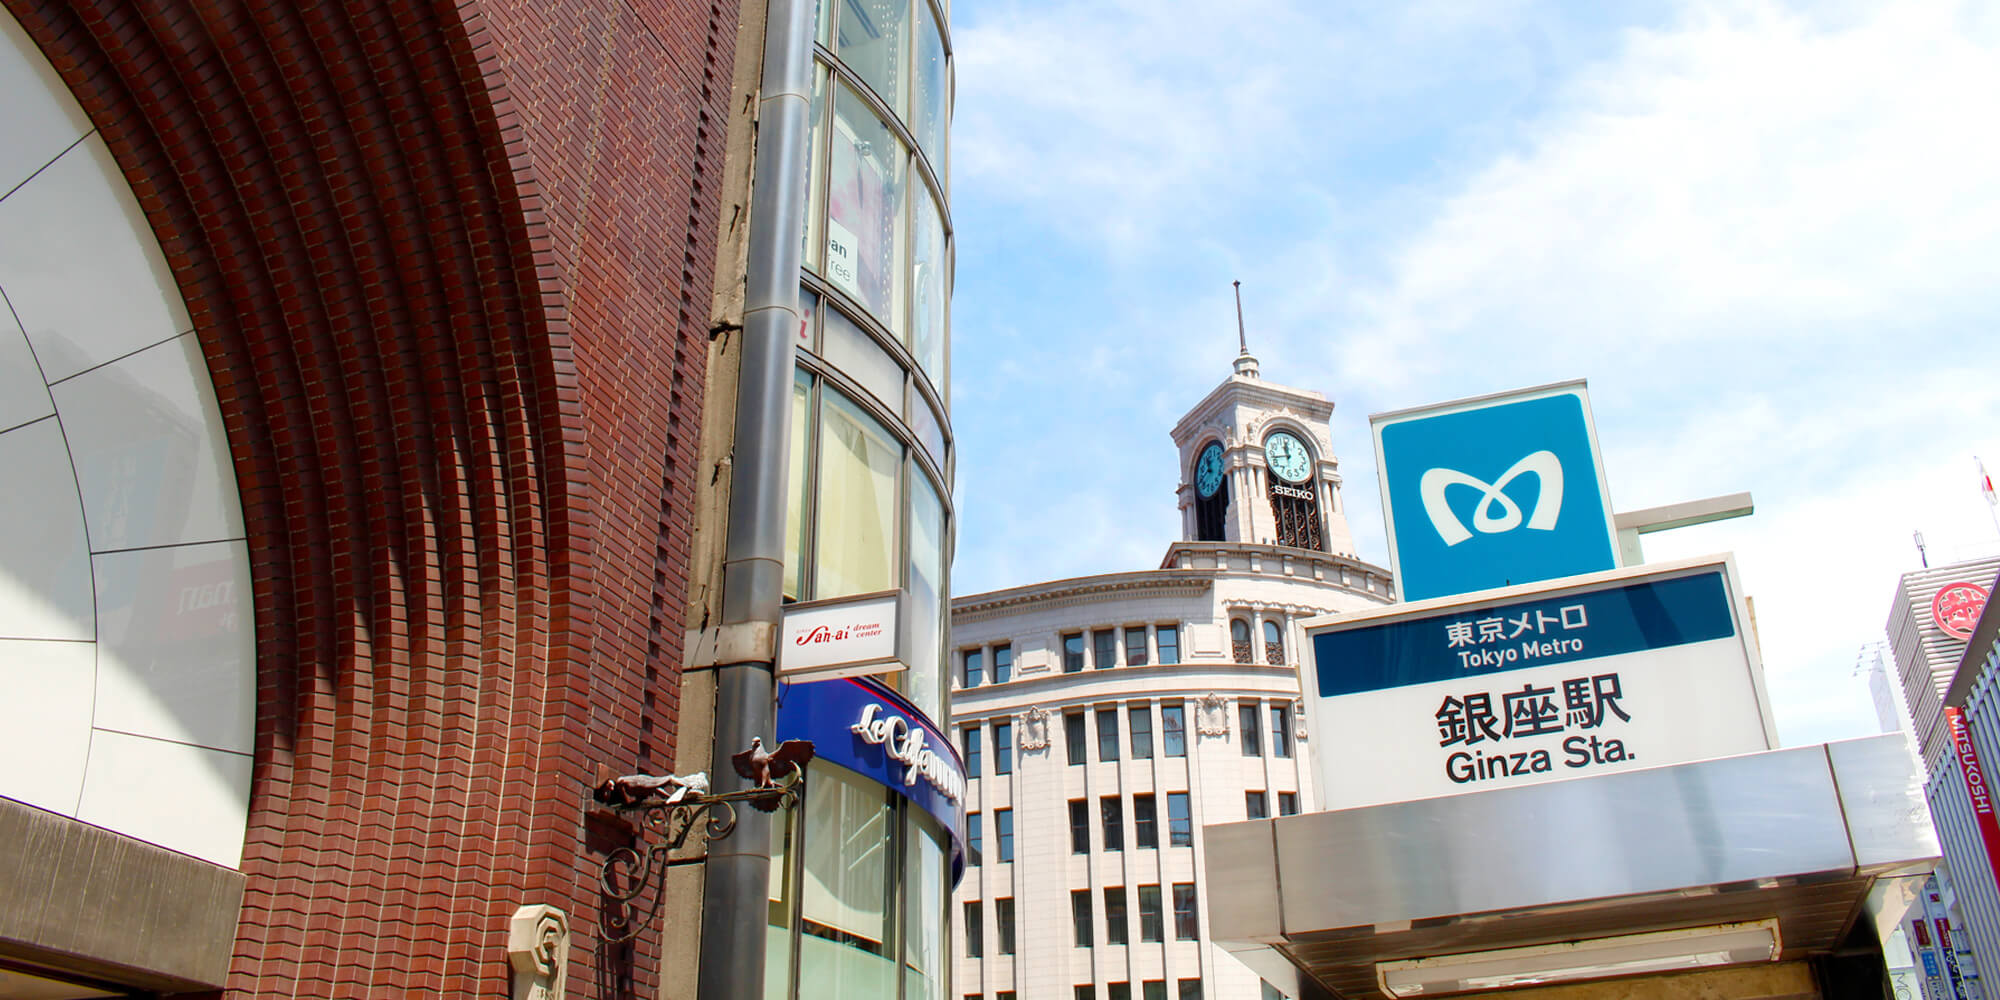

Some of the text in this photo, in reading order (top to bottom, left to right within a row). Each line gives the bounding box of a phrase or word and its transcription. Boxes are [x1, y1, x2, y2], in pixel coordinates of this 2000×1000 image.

[829, 239, 848, 259] an
[1275, 485, 1314, 500] SEIKO
[853, 622, 880, 632] dream
[856, 629, 883, 638] center
[1445, 604, 1589, 649] 東京メトロ
[1457, 635, 1584, 670] Tokyo Metro
[851, 703, 886, 745] Le
[1435, 672, 1631, 748] 銀座駅
[1445, 735, 1635, 785] Ginza Sta.
[1950, 714, 1992, 814] MITSUKOSHI
